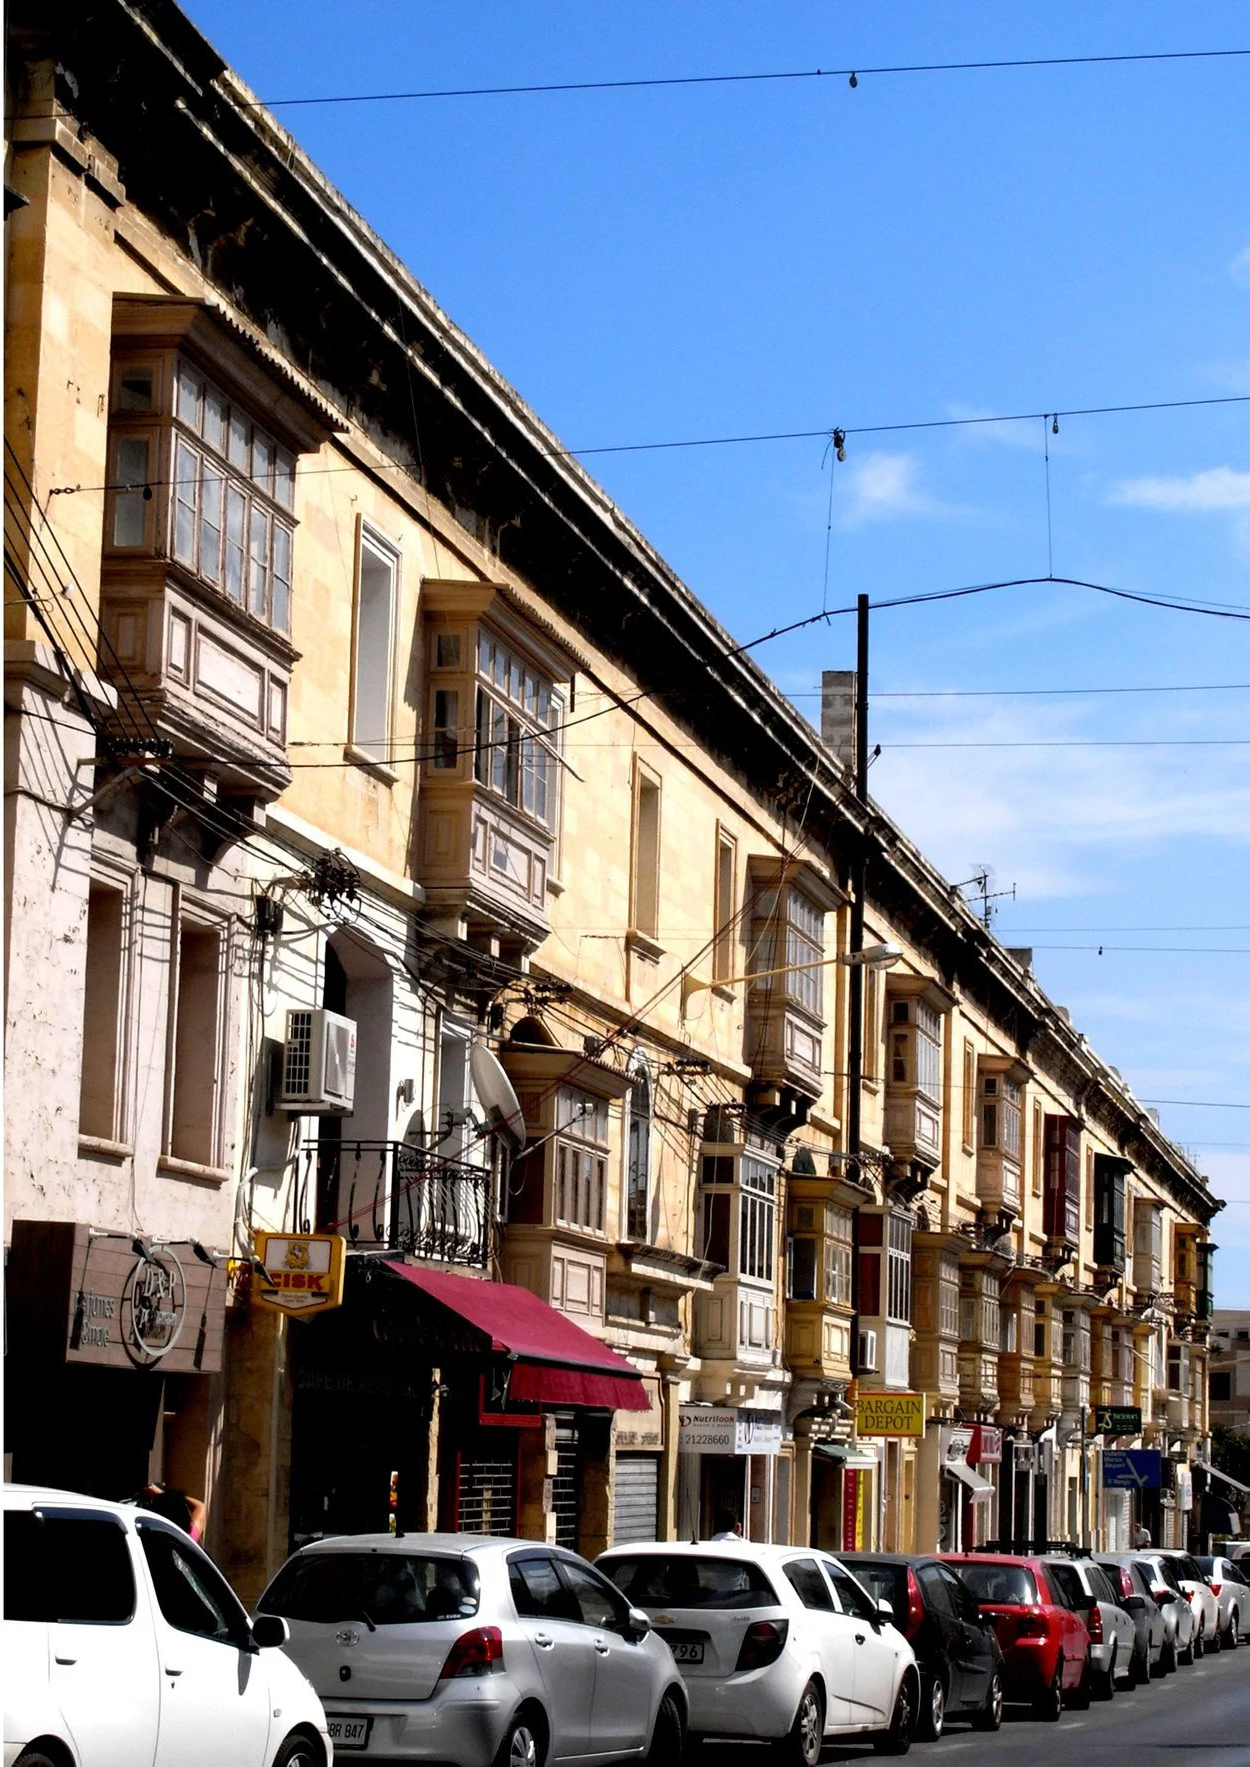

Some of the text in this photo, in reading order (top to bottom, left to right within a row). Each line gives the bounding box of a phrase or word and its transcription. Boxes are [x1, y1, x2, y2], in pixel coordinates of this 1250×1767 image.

[269, 1272, 325, 1291] CISK
[856, 1400, 921, 1415] BARGAIN
[865, 1416, 912, 1430] DEPOT
[685, 1434, 730, 1446] 21228660
[344, 1723, 364, 1739] 847
